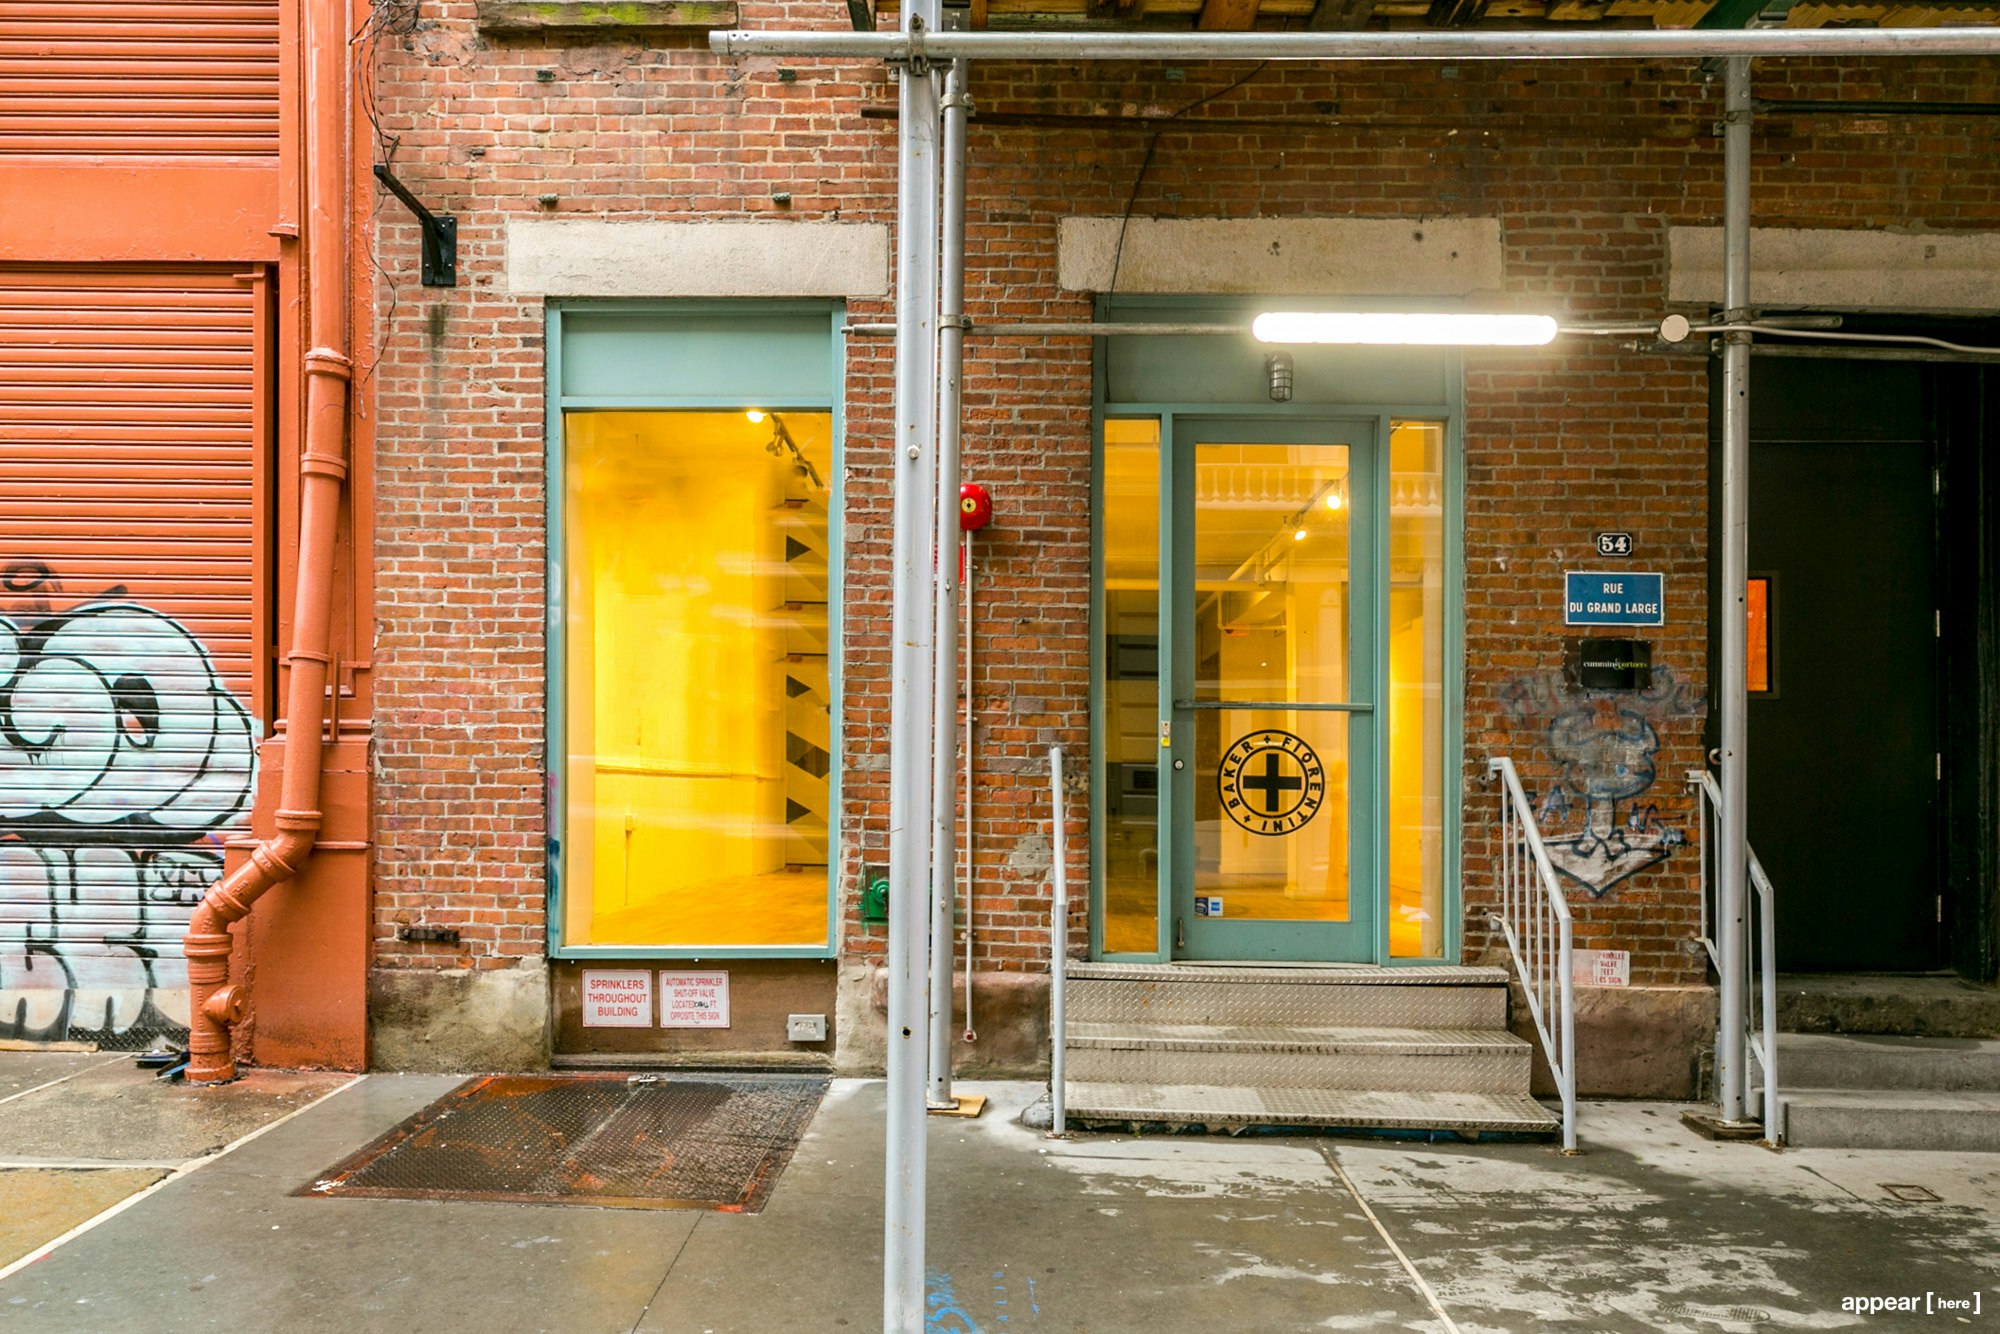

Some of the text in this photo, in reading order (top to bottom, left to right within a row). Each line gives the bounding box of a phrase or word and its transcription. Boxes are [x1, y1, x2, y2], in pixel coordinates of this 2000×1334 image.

[1602, 536, 1627, 552] 54
[1603, 583, 1623, 594] RUE
[1570, 602, 1658, 614] DU GRAND LARGE
[1223, 737, 1321, 832] BAKER FIORENTINI
[590, 979, 645, 990] SPRINKLERS
[666, 977, 723, 987] AUTOMATIC SPRINKLER
[587, 993, 647, 1003] THROUGHOUT
[673, 988, 716, 998] SHUT-OFF VALVE
[671, 1000, 695, 1009] LOCATED
[597, 1006, 638, 1017] BUILDING
[670, 1011, 720, 1021] OPPOSITE THIS SIGN
